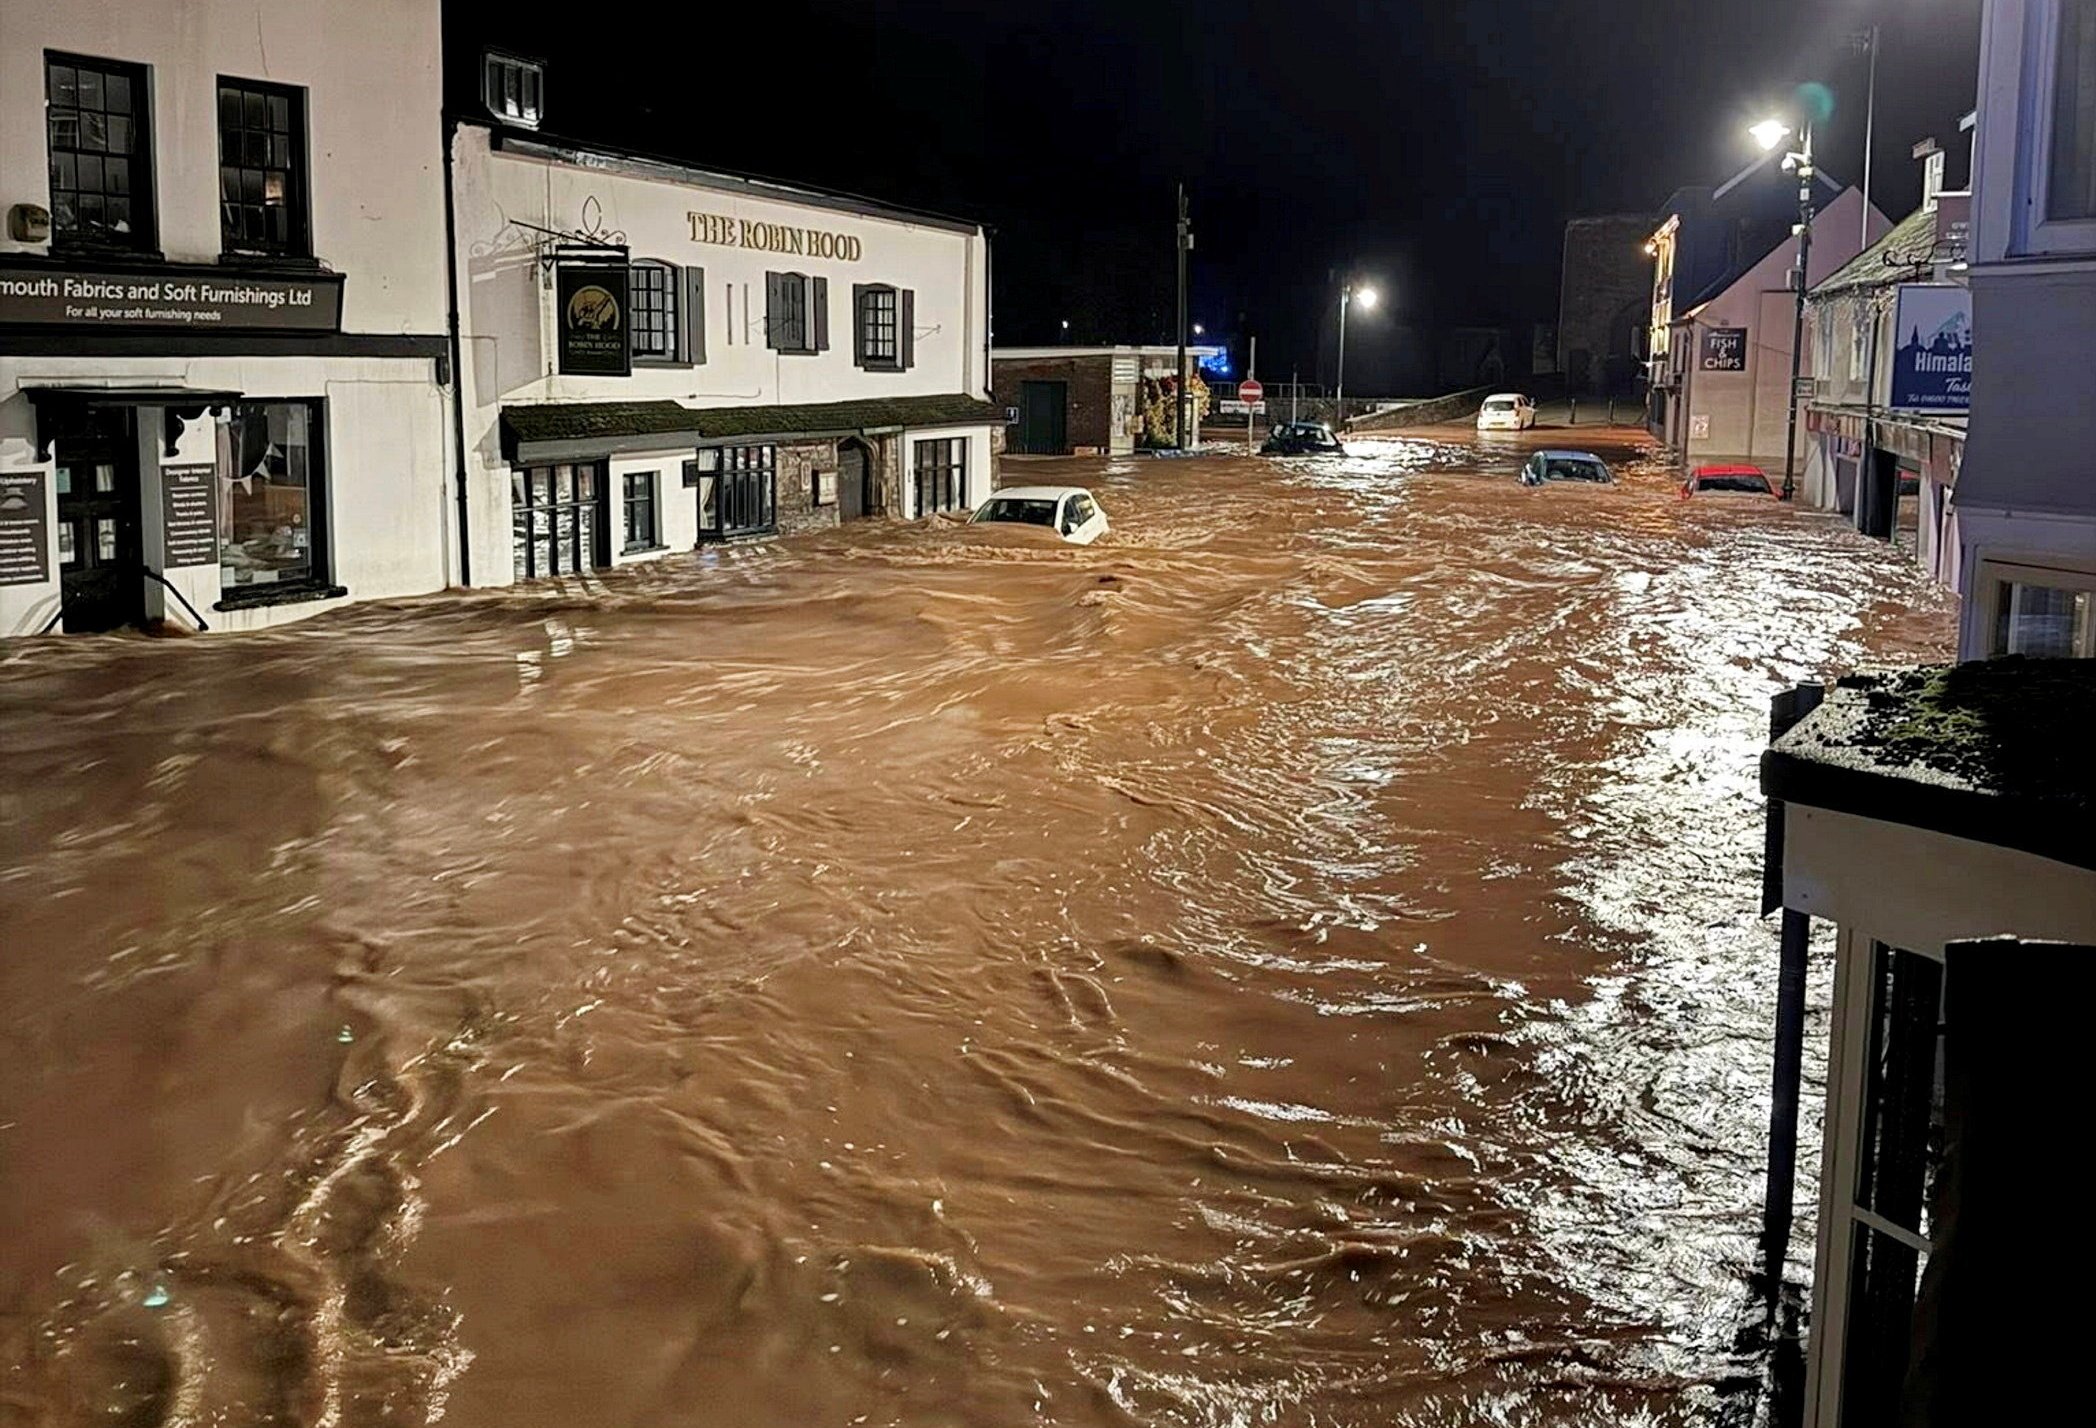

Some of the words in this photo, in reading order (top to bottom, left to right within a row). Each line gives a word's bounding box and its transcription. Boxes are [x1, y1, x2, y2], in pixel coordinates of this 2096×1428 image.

[687, 211, 737, 245] THE
[739, 219, 804, 255] ROBIN
[806, 230, 862, 262] HOOD
[64, 279, 123, 299] Fabrics
[127, 283, 160, 300] and
[164, 283, 196, 301] Soft
[200, 285, 285, 308] Furnishings
[289, 289, 312, 305] Ltd
[66, 305, 83, 317] For
[85, 306, 98, 317] all
[99, 308, 122, 319] your
[124, 307, 143, 319] soft
[145, 307, 191, 322] furnishing
[194, 310, 221, 321] needs
[1710, 338, 1737, 349] FISH
[1718, 348, 1727, 358] &
[1704, 358, 1741, 369] CHIPS
